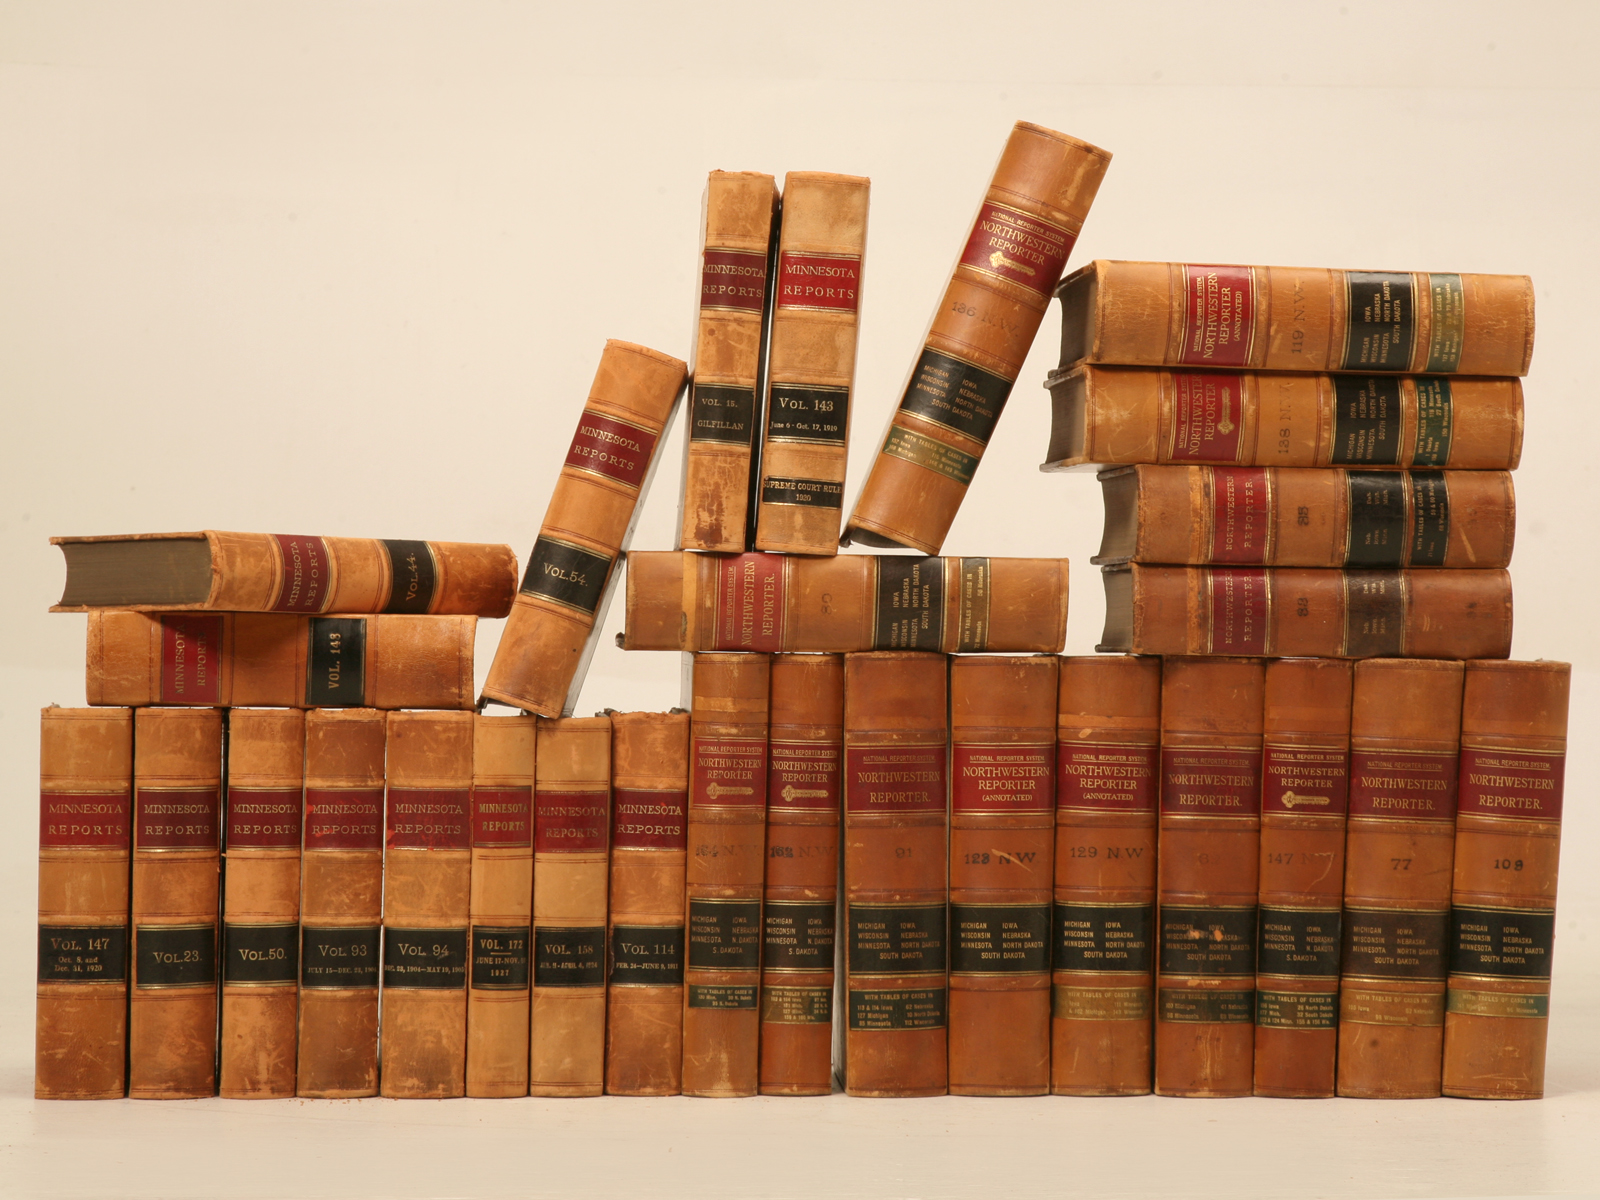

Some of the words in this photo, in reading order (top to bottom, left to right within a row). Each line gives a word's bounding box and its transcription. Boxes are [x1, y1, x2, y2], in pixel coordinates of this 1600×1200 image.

[1017, 220, 1044, 233] REPORTER
[1045, 231, 1065, 242] SYSTEM
[980, 221, 1066, 259] NORTHWESTERN
[989, 237, 1045, 265] REPORTER
[704, 265, 764, 278] MINNESOTA
[786, 264, 855, 278] MINNESOTA
[703, 285, 762, 297] REPORTS
[784, 285, 854, 299] REPORTS
[1203, 272, 1218, 358] NORTHWESTERN
[1219, 288, 1231, 344] REPORTER
[1234, 291, 1242, 341] (ANNOTATED)
[1292, 330, 1304, 354] 119
[962, 379, 977, 389] IOWA
[814, 400, 833, 411] 143
[932, 399, 950, 410] SOUTH
[952, 407, 973, 420] DAKOTA
[1189, 374, 1203, 455] NORTHWESTER
[1205, 383, 1215, 440] REPORTER
[697, 420, 744, 430] GILFILLAN
[580, 426, 641, 452] MINNESOTA
[574, 445, 634, 470] REPORTS
[798, 484, 821, 492] COURT
[1226, 476, 1234, 550] NORTHWESTERN
[287, 542, 302, 607] MINNESOTA
[304, 542, 319, 607] REPORTS
[741, 561, 755, 645] NORTHWESTERN
[762, 574, 775, 636] REPORTER.
[1225, 571, 1233, 644] NORTHWESTERN
[175, 623, 185, 694] MINNESOTA
[197, 632, 206, 686] REPORTS
[328, 660, 340, 689] VOL.
[698, 758, 762, 768] NORTHWESTERN
[772, 761, 836, 771] NORTHWESTERN
[707, 770, 752, 779] REPORTER
[963, 767, 1049, 777] NORTHWESTERN
[1066, 765, 1151, 777] NORTHWESTERN
[1269, 766, 1345, 776] NORTHWESTERN
[782, 773, 828, 782] REPORTER
[858, 772, 940, 782] NORTHWESTERN
[1169, 774, 1254, 786] NORTHWESTERN
[1281, 778, 1333, 787] REPORTER
[1470, 774, 1554, 789] NORTHWESTERN
[978, 780, 1036, 790] REPORTER
[1080, 779, 1137, 789] REPORTER
[1362, 777, 1447, 790] NORTHWESTERN
[870, 792, 931, 803] REPORTER.
[1083, 793, 1133, 801] (ANNOTATED)
[1179, 794, 1242, 806] REPORTER.
[1479, 795, 1543, 809] REPORTER.
[49, 804, 123, 813] MINNESOTA
[144, 805, 210, 813] MINNESOTA
[233, 804, 298, 813] MINNESOTA
[395, 804, 463, 814] MINNESOTA
[479, 803, 528, 813] MINNESOTA
[1373, 797, 1435, 810] REPORTER.
[313, 805, 378, 814] MINNESOTA
[539, 807, 606, 816] MINNESOTA
[618, 804, 682, 816] MINNESOTA
[48, 825, 123, 835] REPORTS
[145, 826, 210, 835] REPORTS
[234, 825, 297, 834] REPORTS
[312, 826, 376, 834] REPORTS
[394, 824, 461, 834] REPORTS
[482, 822, 525, 831] REPORTS
[617, 825, 680, 835] REPORTS
[546, 828, 598, 837] REPORTS
[896, 848, 912, 858] 91
[1071, 847, 1097, 858] 129
[1268, 853, 1293, 864] 147
[1391, 858, 1412, 870] 77
[1461, 924, 1488, 932] MICHIGAN
[88, 938, 110, 950] 147
[480, 939, 503, 949] VOL.
[509, 939, 523, 949] 172
[545, 944, 571, 954] VOL.
[578, 944, 593, 954] 158
[654, 944, 674, 954] 114
[352, 945, 367, 956] 93
[433, 944, 449, 956] 94
[1503, 956, 1525, 964] DAKOTA
